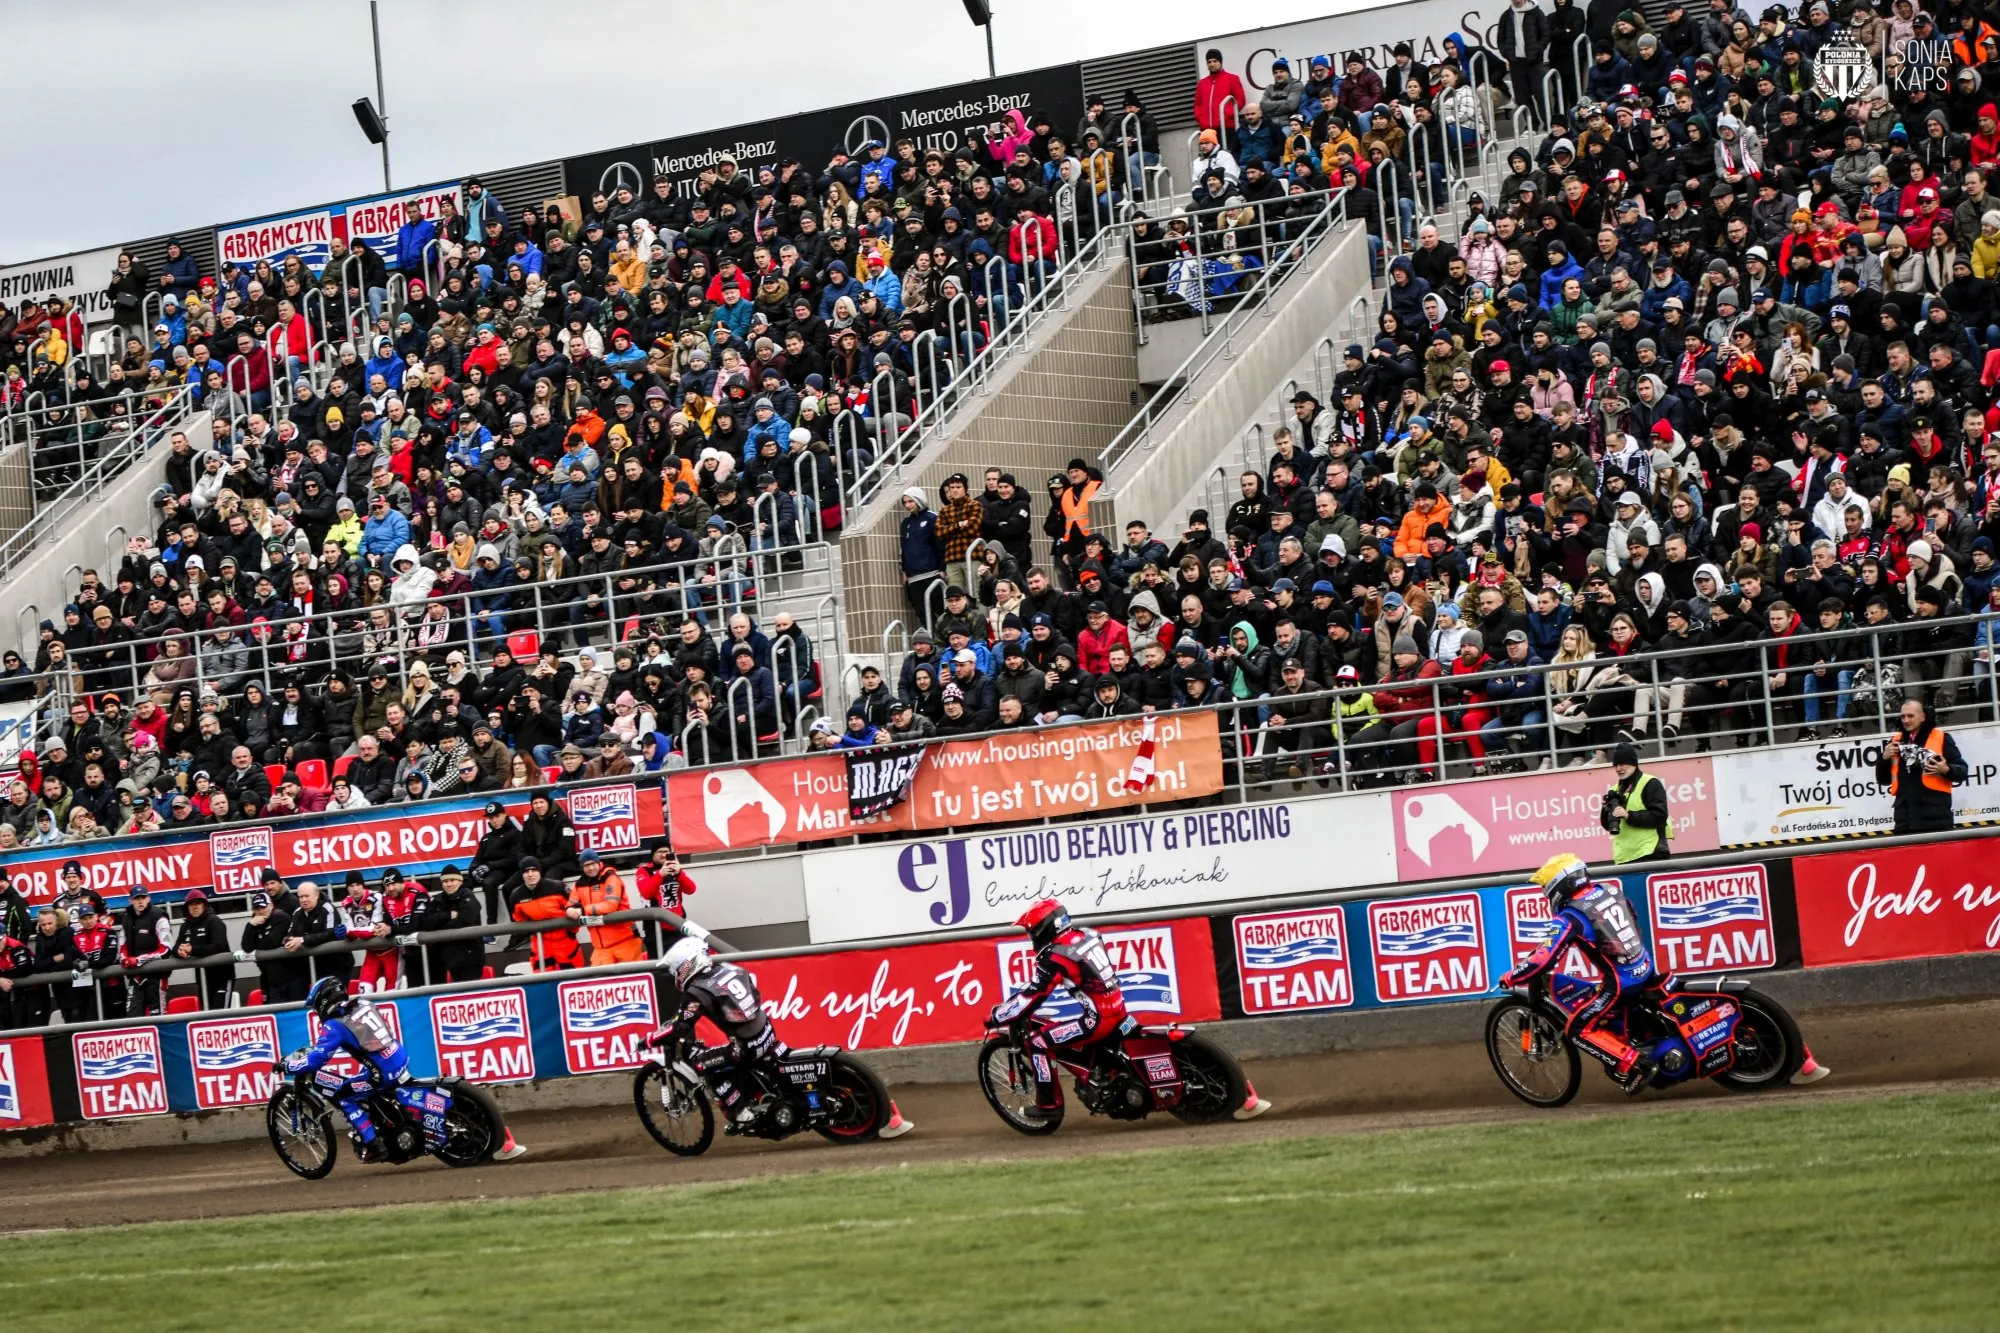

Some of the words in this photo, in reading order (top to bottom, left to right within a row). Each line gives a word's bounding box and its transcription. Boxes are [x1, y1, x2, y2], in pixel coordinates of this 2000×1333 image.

[900, 92, 1031, 130] Mercedes-Benz
[653, 140, 776, 176] Mercedes-Benz
[223, 216, 327, 261] ABRAMCZYK
[0, 265, 75, 299] RTOWNIA
[930, 717, 1183, 771] www.housingmarke.pl
[1815, 739, 1889, 772] świa
[574, 788, 630, 811] ABRAMCZYK
[793, 770, 849, 797] Hous
[931, 790, 962, 818] Tu
[971, 780, 1024, 820] jest
[1030, 771, 1098, 808] Twój
[1106, 760, 1188, 798] dm!
[1779, 780, 1832, 805] Twój
[1951, 764, 1997, 788] HP
[1491, 788, 1602, 823] Housing
[576, 823, 637, 851] TEAM
[982, 830, 1061, 871] STUDIO
[1067, 820, 1156, 862] BEAUTY
[1163, 817, 1179, 850] &
[1185, 804, 1292, 849] PIERCING
[1508, 811, 1696, 845] www.housin.pl
[1781, 824, 1792, 833] ul.
[1792, 820, 1837, 833] Fordońska
[1858, 816, 1894, 828] Bydgosz
[215, 832, 268, 851] ABRAMCZYK
[292, 830, 394, 867] SEKTOR
[7, 871, 50, 899] OR
[55, 853, 193, 894] RODZINNY
[984, 876, 1085, 908] Emilia
[1094, 856, 1229, 907] Jaśkowiak
[1658, 875, 1758, 907] ABRAMCZYK
[1378, 904, 1472, 933] ABRAMCZYK
[1602, 904, 1630, 932] 12
[1843, 862, 1942, 948] Jak
[1244, 917, 1336, 946] ABRAMCZYK
[1086, 945, 1110, 972] 10
[1659, 928, 1770, 970] TEAM
[727, 978, 747, 1000] 9
[1246, 968, 1348, 1008] TEAM
[1380, 955, 1484, 996] TEAM
[439, 998, 519, 1025] ABRAMCZYK
[568, 983, 648, 1011] ABRAMCZYK
[749, 972, 811, 1020] ak
[819, 959, 935, 1051] ryby,
[934, 959, 983, 1007] to
[196, 1024, 271, 1051] ABRAMCZYK
[361, 1010, 384, 1032] 11
[1697, 1019, 1728, 1041] BETARD
[81, 1035, 153, 1060] ABRAMCZYK
[442, 1044, 530, 1080] TEAM
[784, 1063, 815, 1073] BETARD
[1150, 1069, 1176, 1081] TEAM
[84, 1080, 164, 1114] TEAM
[199, 1068, 282, 1104] TEAM
[426, 1102, 444, 1113] TEAM
